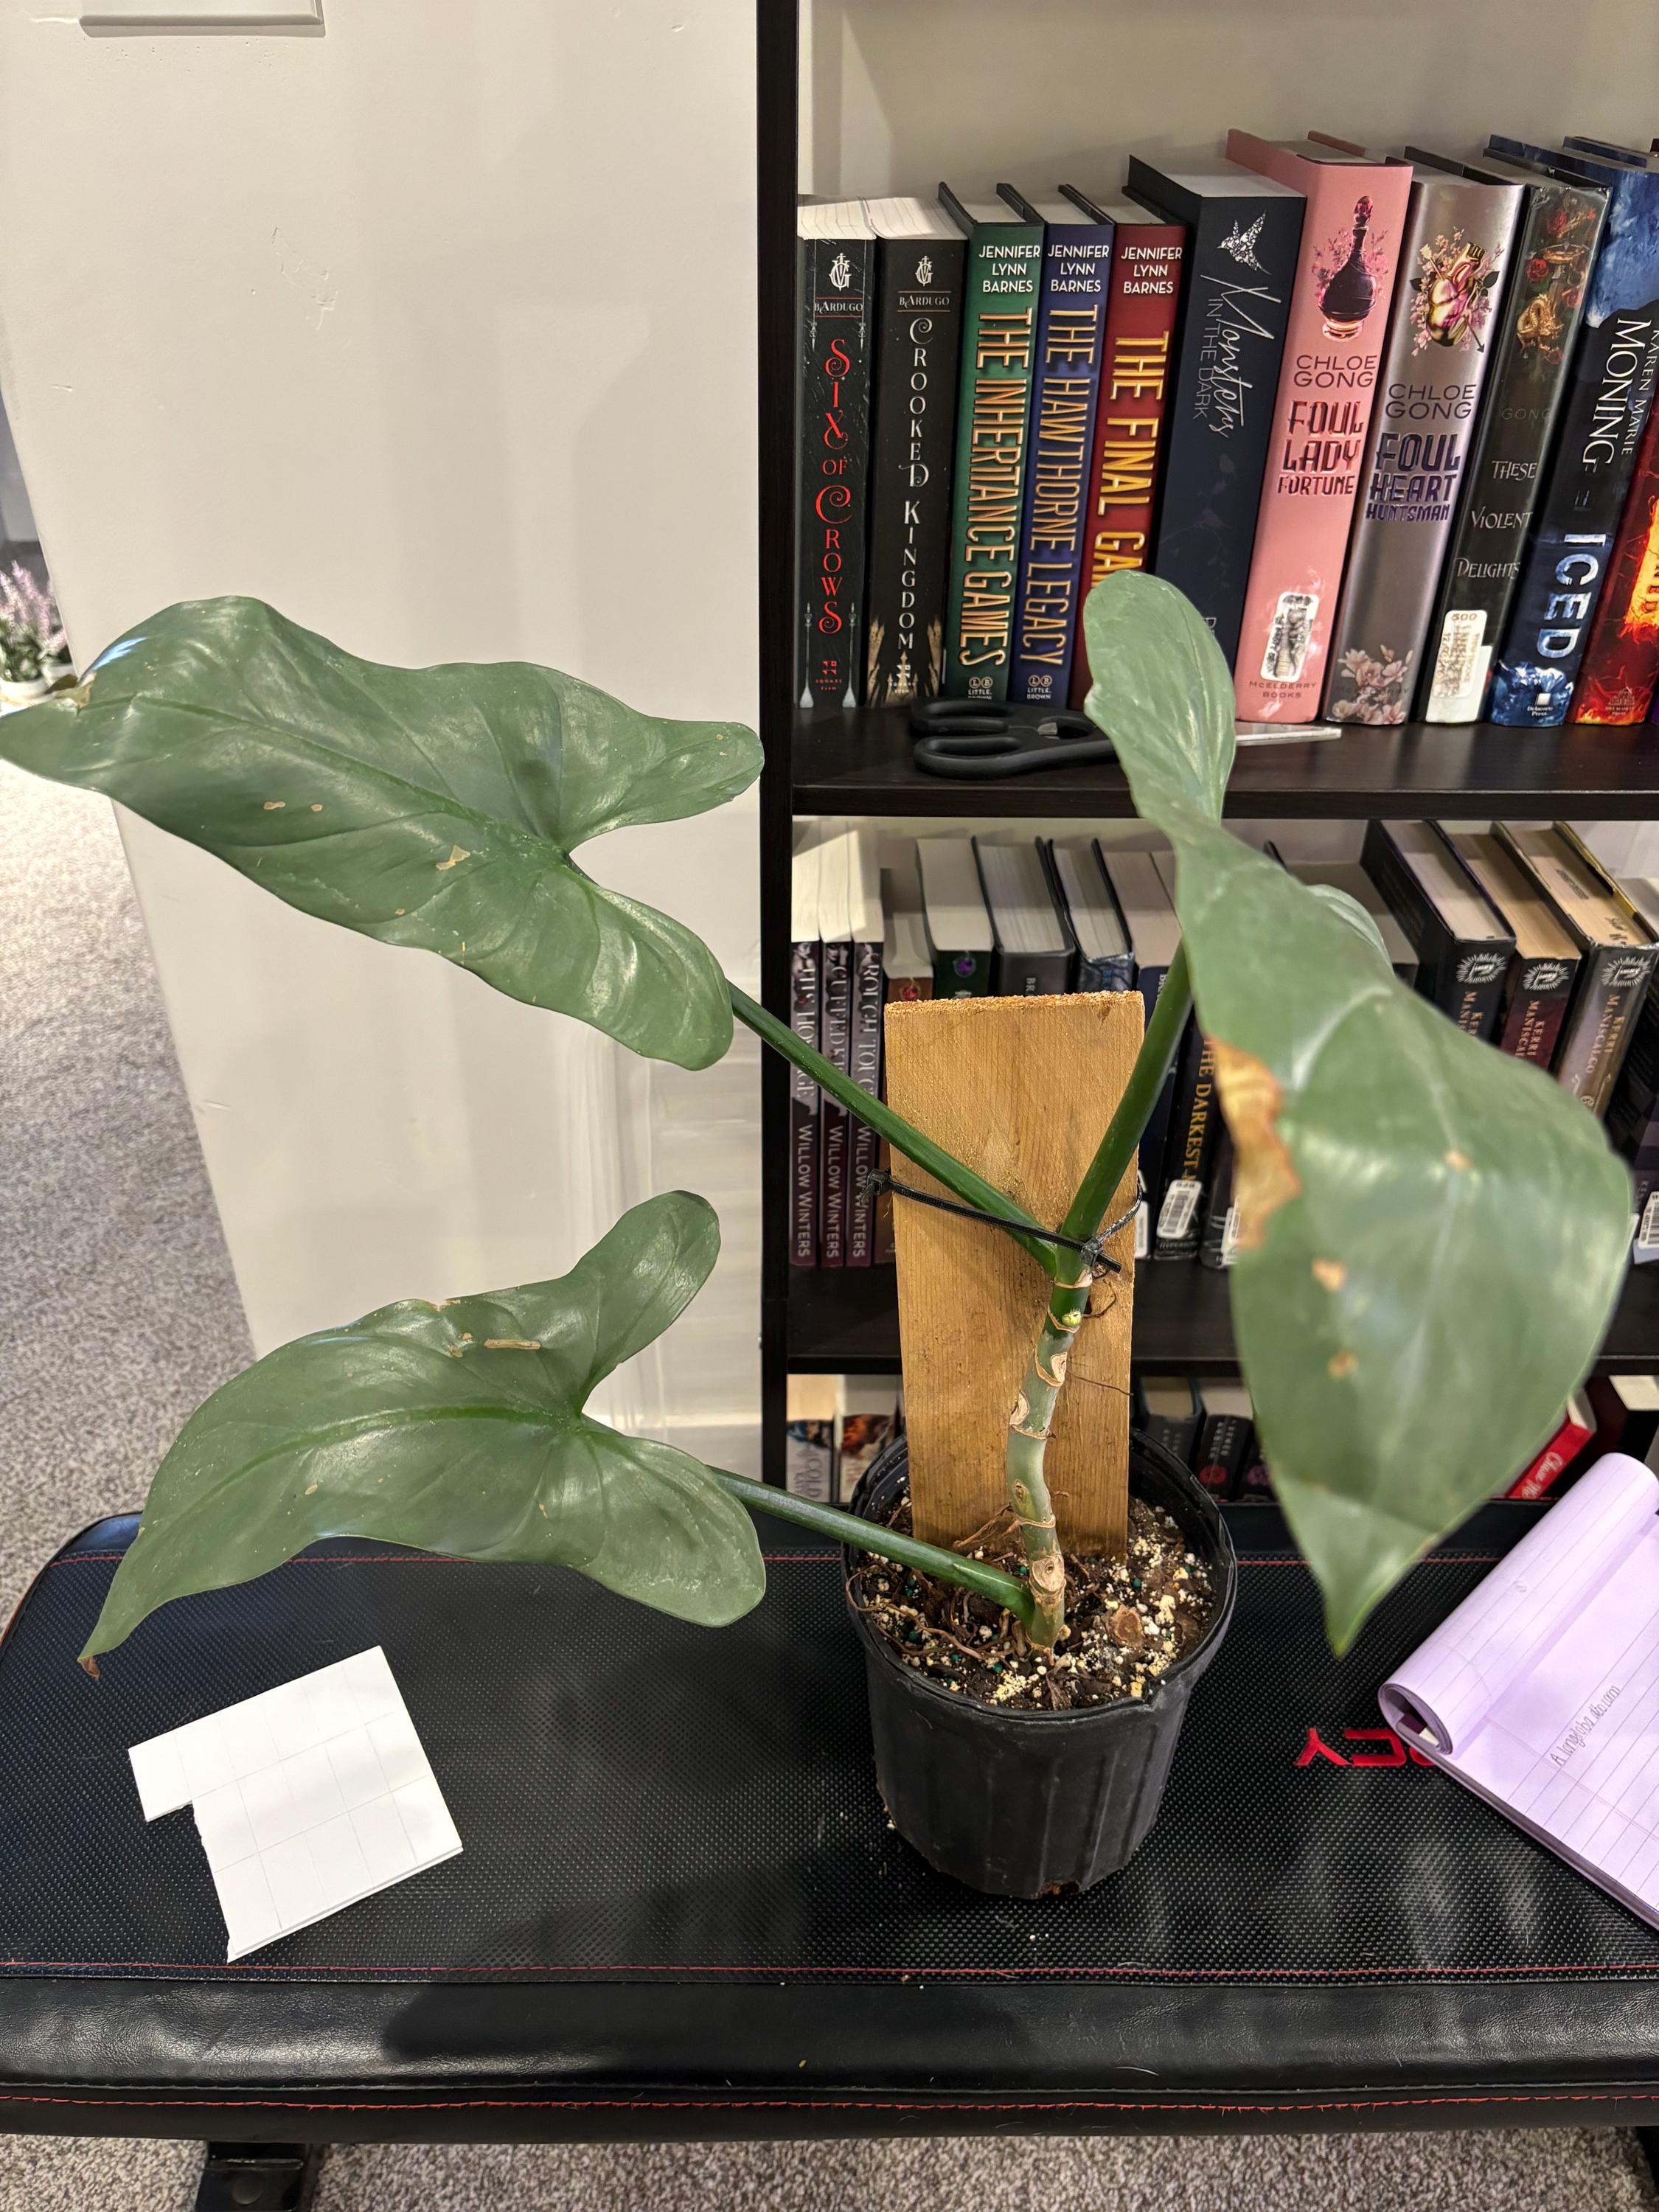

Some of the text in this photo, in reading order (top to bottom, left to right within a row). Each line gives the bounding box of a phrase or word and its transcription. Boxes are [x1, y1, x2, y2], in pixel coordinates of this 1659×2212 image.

[978, 245, 1040, 259] JENNIFER
[1047, 244, 1110, 258] JENNIFER
[1121, 246, 1183, 260] JENNIFER
[992, 262, 1026, 276] LYNN
[1060, 262, 1095, 275] LYNN
[1133, 265, 1168, 277] LYNN
[899, 295, 950, 309] BARDUGO
[982, 279, 1034, 293] BARNES
[1050, 279, 1101, 293] BARNES
[1123, 281, 1174, 294] BARNES
[814, 300, 863, 315] BARDUGO
[976, 307, 1032, 369] THE
[1193, 299, 1224, 420] IN THE DARK
[1296, 355, 1378, 371] CHLOE
[1293, 371, 1374, 389] GONG
[1388, 383, 1477, 401] CHLOE
[1582, 317, 1652, 465] MONING
[1621, 330, 1659, 455] KAREN MARIE
[898, 318, 933, 487] CROOKED
[1287, 400, 1365, 437] FOUL
[1385, 401, 1472, 420] GONG
[1091, 330, 1169, 588] THE FINAL GA
[1282, 439, 1362, 474] LADY
[1375, 432, 1461, 473] FOUL
[815, 338, 853, 635] SIX OF CROWS
[964, 378, 1027, 563] INHERITANCE
[1020, 304, 1098, 665] THE HAWTHORNE LEGACY
[1277, 475, 1356, 496] FORTUNE
[1492, 460, 1537, 481] THESE
[1369, 473, 1458, 503] HEART
[1366, 503, 1450, 522] HUNTSMAN
[1471, 506, 1533, 529] VIOLENT
[897, 501, 920, 650] KINGDOM
[1455, 557, 1521, 580] DELIGHTS
[1537, 533, 1607, 658] ICED
[959, 571, 1012, 667] GAMES
[860, 963, 880, 1033] ROUGH
[1586, 995, 1621, 1074] MANISCALCO
[1183, 1083, 1211, 1169] DARKEST
[855, 1126, 872, 1187] WILLOW
[797, 1124, 813, 1258] WILLOW WINTERS
[826, 1125, 844, 1259] WILLOW WINTERS
